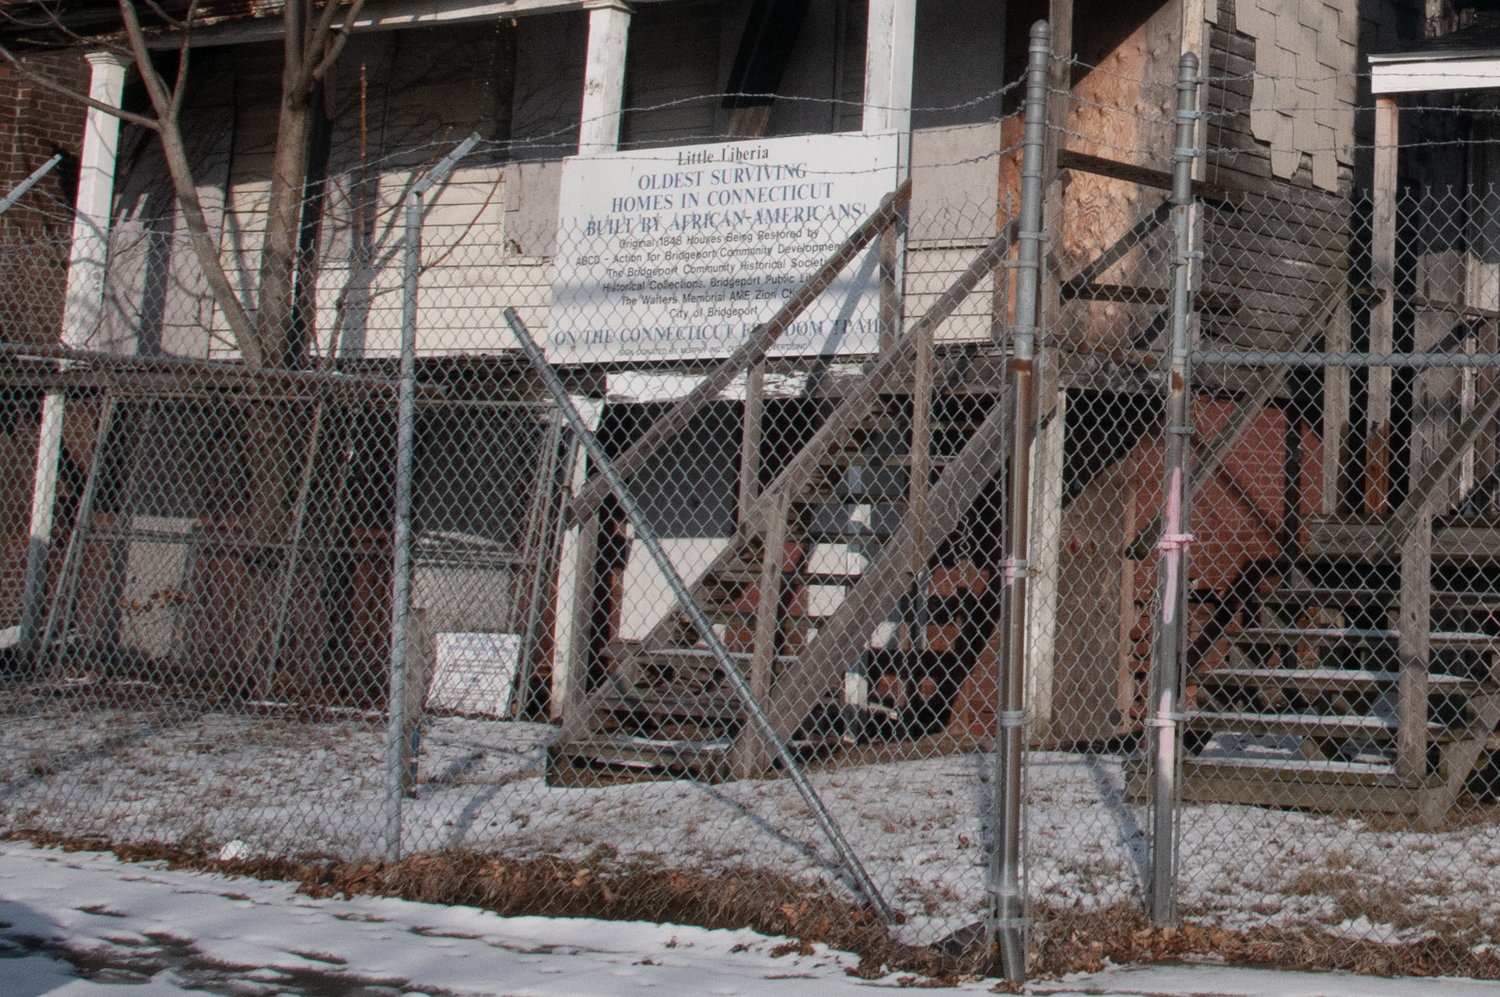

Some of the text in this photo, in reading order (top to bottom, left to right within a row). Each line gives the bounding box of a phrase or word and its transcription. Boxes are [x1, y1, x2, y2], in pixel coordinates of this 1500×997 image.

[678, 146, 769, 165] Little Liberia
[638, 163, 808, 191] OLDEST SURVIVING
[611, 182, 834, 213] HOMES IN CONNECTICUT
[586, 202, 863, 236] BUILT BY AFRICAN-AMERICANS
[619, 228, 819, 250] Original 1848 Houses Being Restored by
[576, 256, 600, 266] ABCD
[614, 253, 642, 264] Action
[647, 252, 660, 262] for
[665, 249, 716, 262] Bridgeport
[720, 246, 772, 259] Community
[778, 242, 843, 254] Developmen
[608, 268, 623, 278] The
[628, 266, 678, 279] Bridgeport
[683, 262, 735, 275] Community
[741, 259, 786, 270] Historical
[603, 282, 645, 292] Historical
[711, 276, 760, 289] Bridgeport
[766, 274, 795, 284] Public
[621, 296, 636, 305] The
[682, 292, 725, 303] Memorial
[730, 291, 750, 301] AME
[755, 289, 777, 300] Zion
[669, 305, 758, 320] City of Bridgeport
[554, 331, 577, 346] ON
[582, 329, 615, 344] THE
[620, 323, 734, 343] CONNECTICUT
